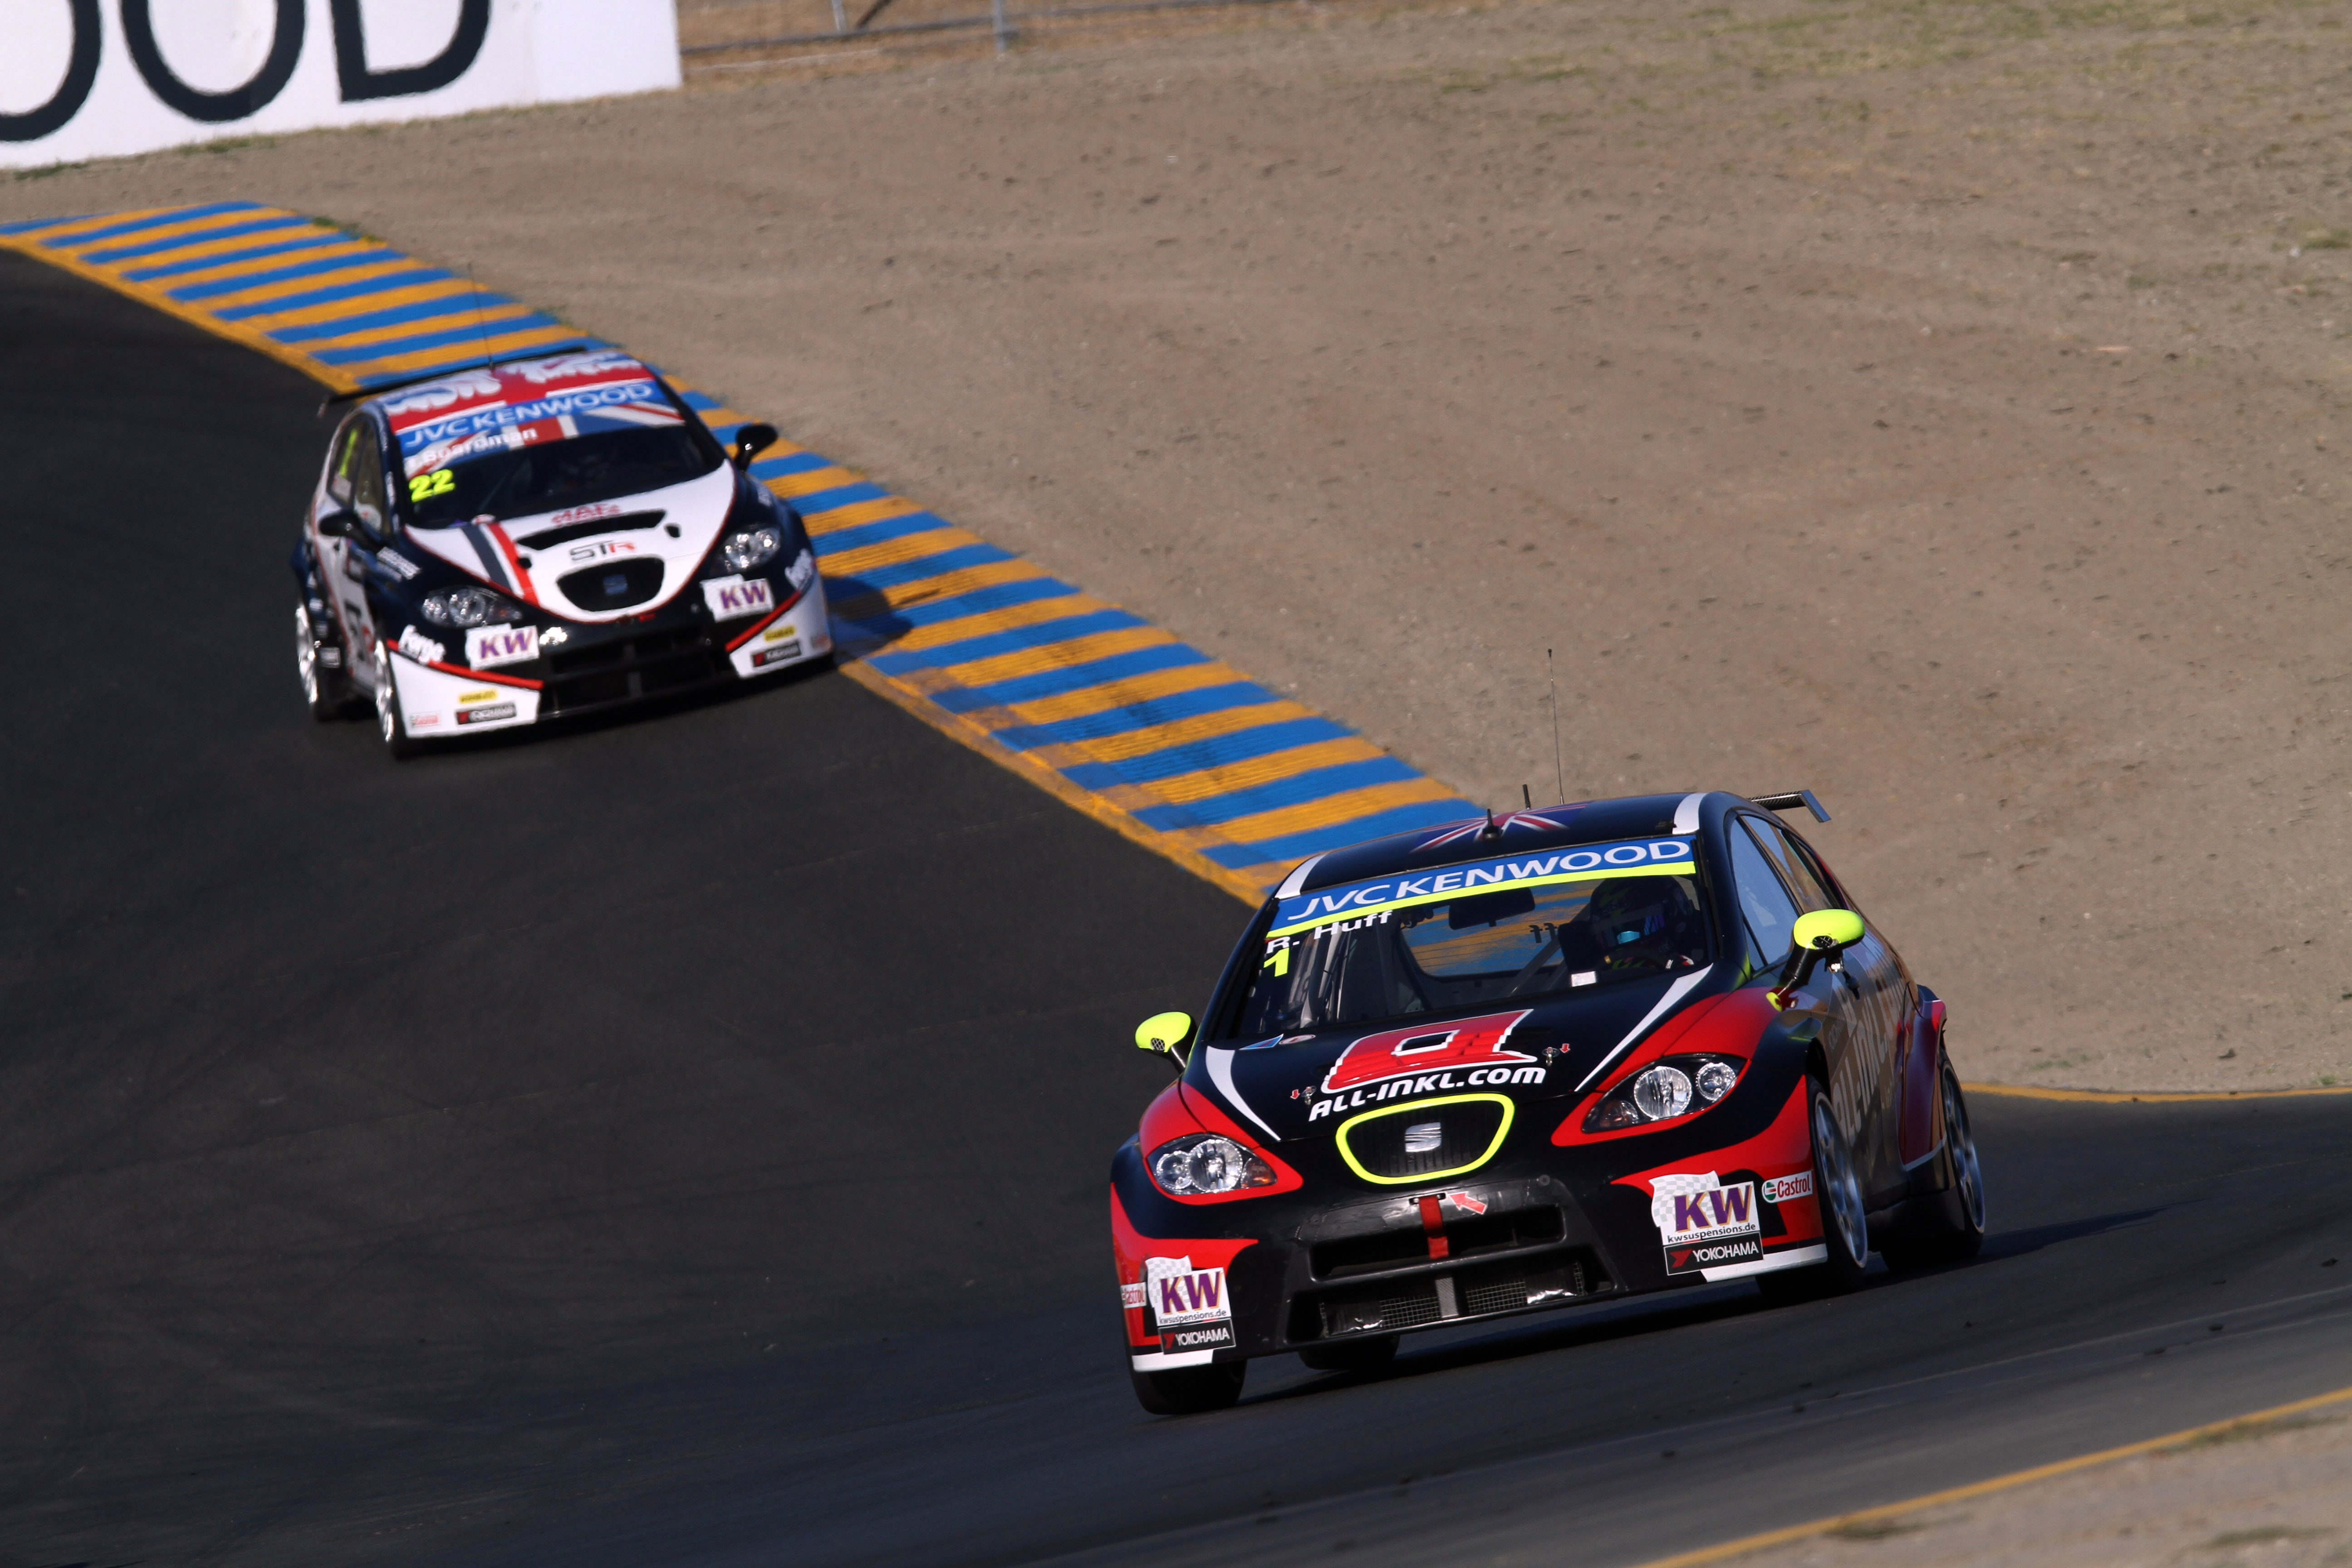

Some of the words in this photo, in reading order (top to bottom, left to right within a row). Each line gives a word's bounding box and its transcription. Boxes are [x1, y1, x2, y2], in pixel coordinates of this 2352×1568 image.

[407, 418, 469, 447] JVC
[472, 383, 652, 430] KENWOOD
[408, 468, 456, 502] 22
[720, 581, 766, 609] KW
[480, 629, 533, 658] KW
[1287, 884, 1391, 921] JVC
[1395, 840, 1691, 899] KENWOOD
[1266, 936, 1300, 954] R.
[1313, 909, 1393, 940] Huff
[1263, 947, 1290, 977] 1
[1777, 1173, 1811, 1198] Castrol
[1674, 1184, 1754, 1232] KW
[1667, 1222, 1756, 1244] kwsuspensions.de
[1692, 1240, 1759, 1263] YOKOHAMA
[1159, 1270, 1224, 1315] KW
[1159, 1308, 1227, 1324] kwsuspensions.de
[1175, 1327, 1230, 1346] YOKOHAMA
